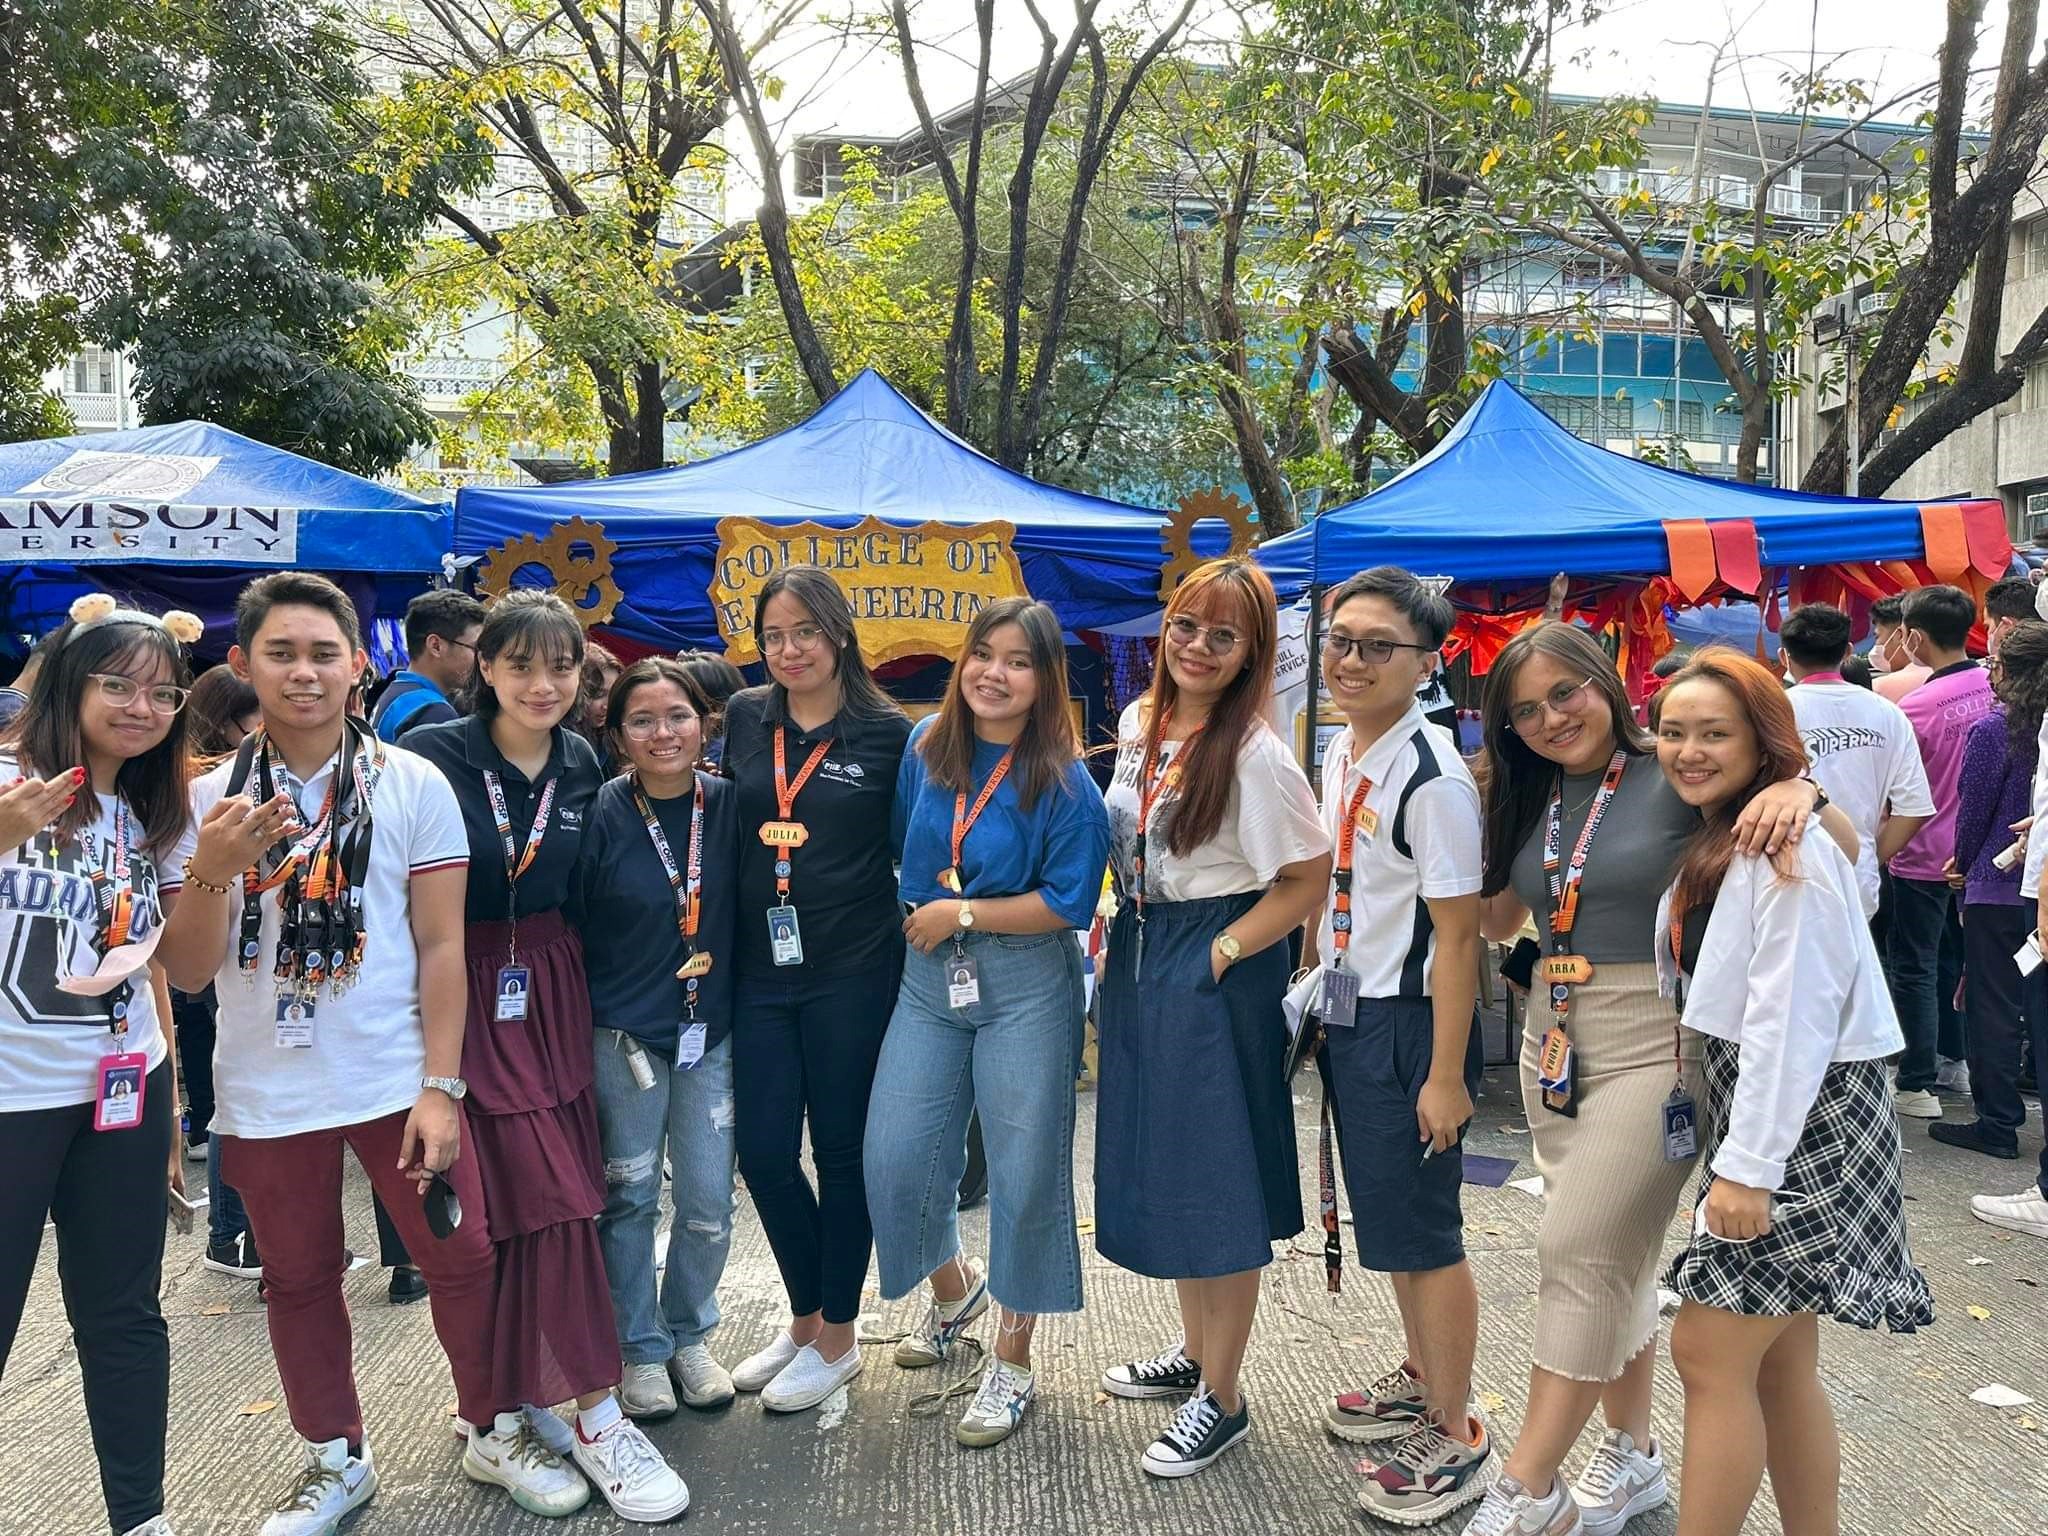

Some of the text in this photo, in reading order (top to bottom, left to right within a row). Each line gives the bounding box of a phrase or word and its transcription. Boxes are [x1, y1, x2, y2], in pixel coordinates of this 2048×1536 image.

[719, 531, 1003, 591] COLLEGE OF
[719, 585, 997, 636] EEERIN
[1800, 728, 1887, 769] SUPERMAN
[766, 829, 798, 841] JULIA
[1582, 792, 1613, 855] ENGINEERING
[1548, 963, 1577, 975] ARRA
